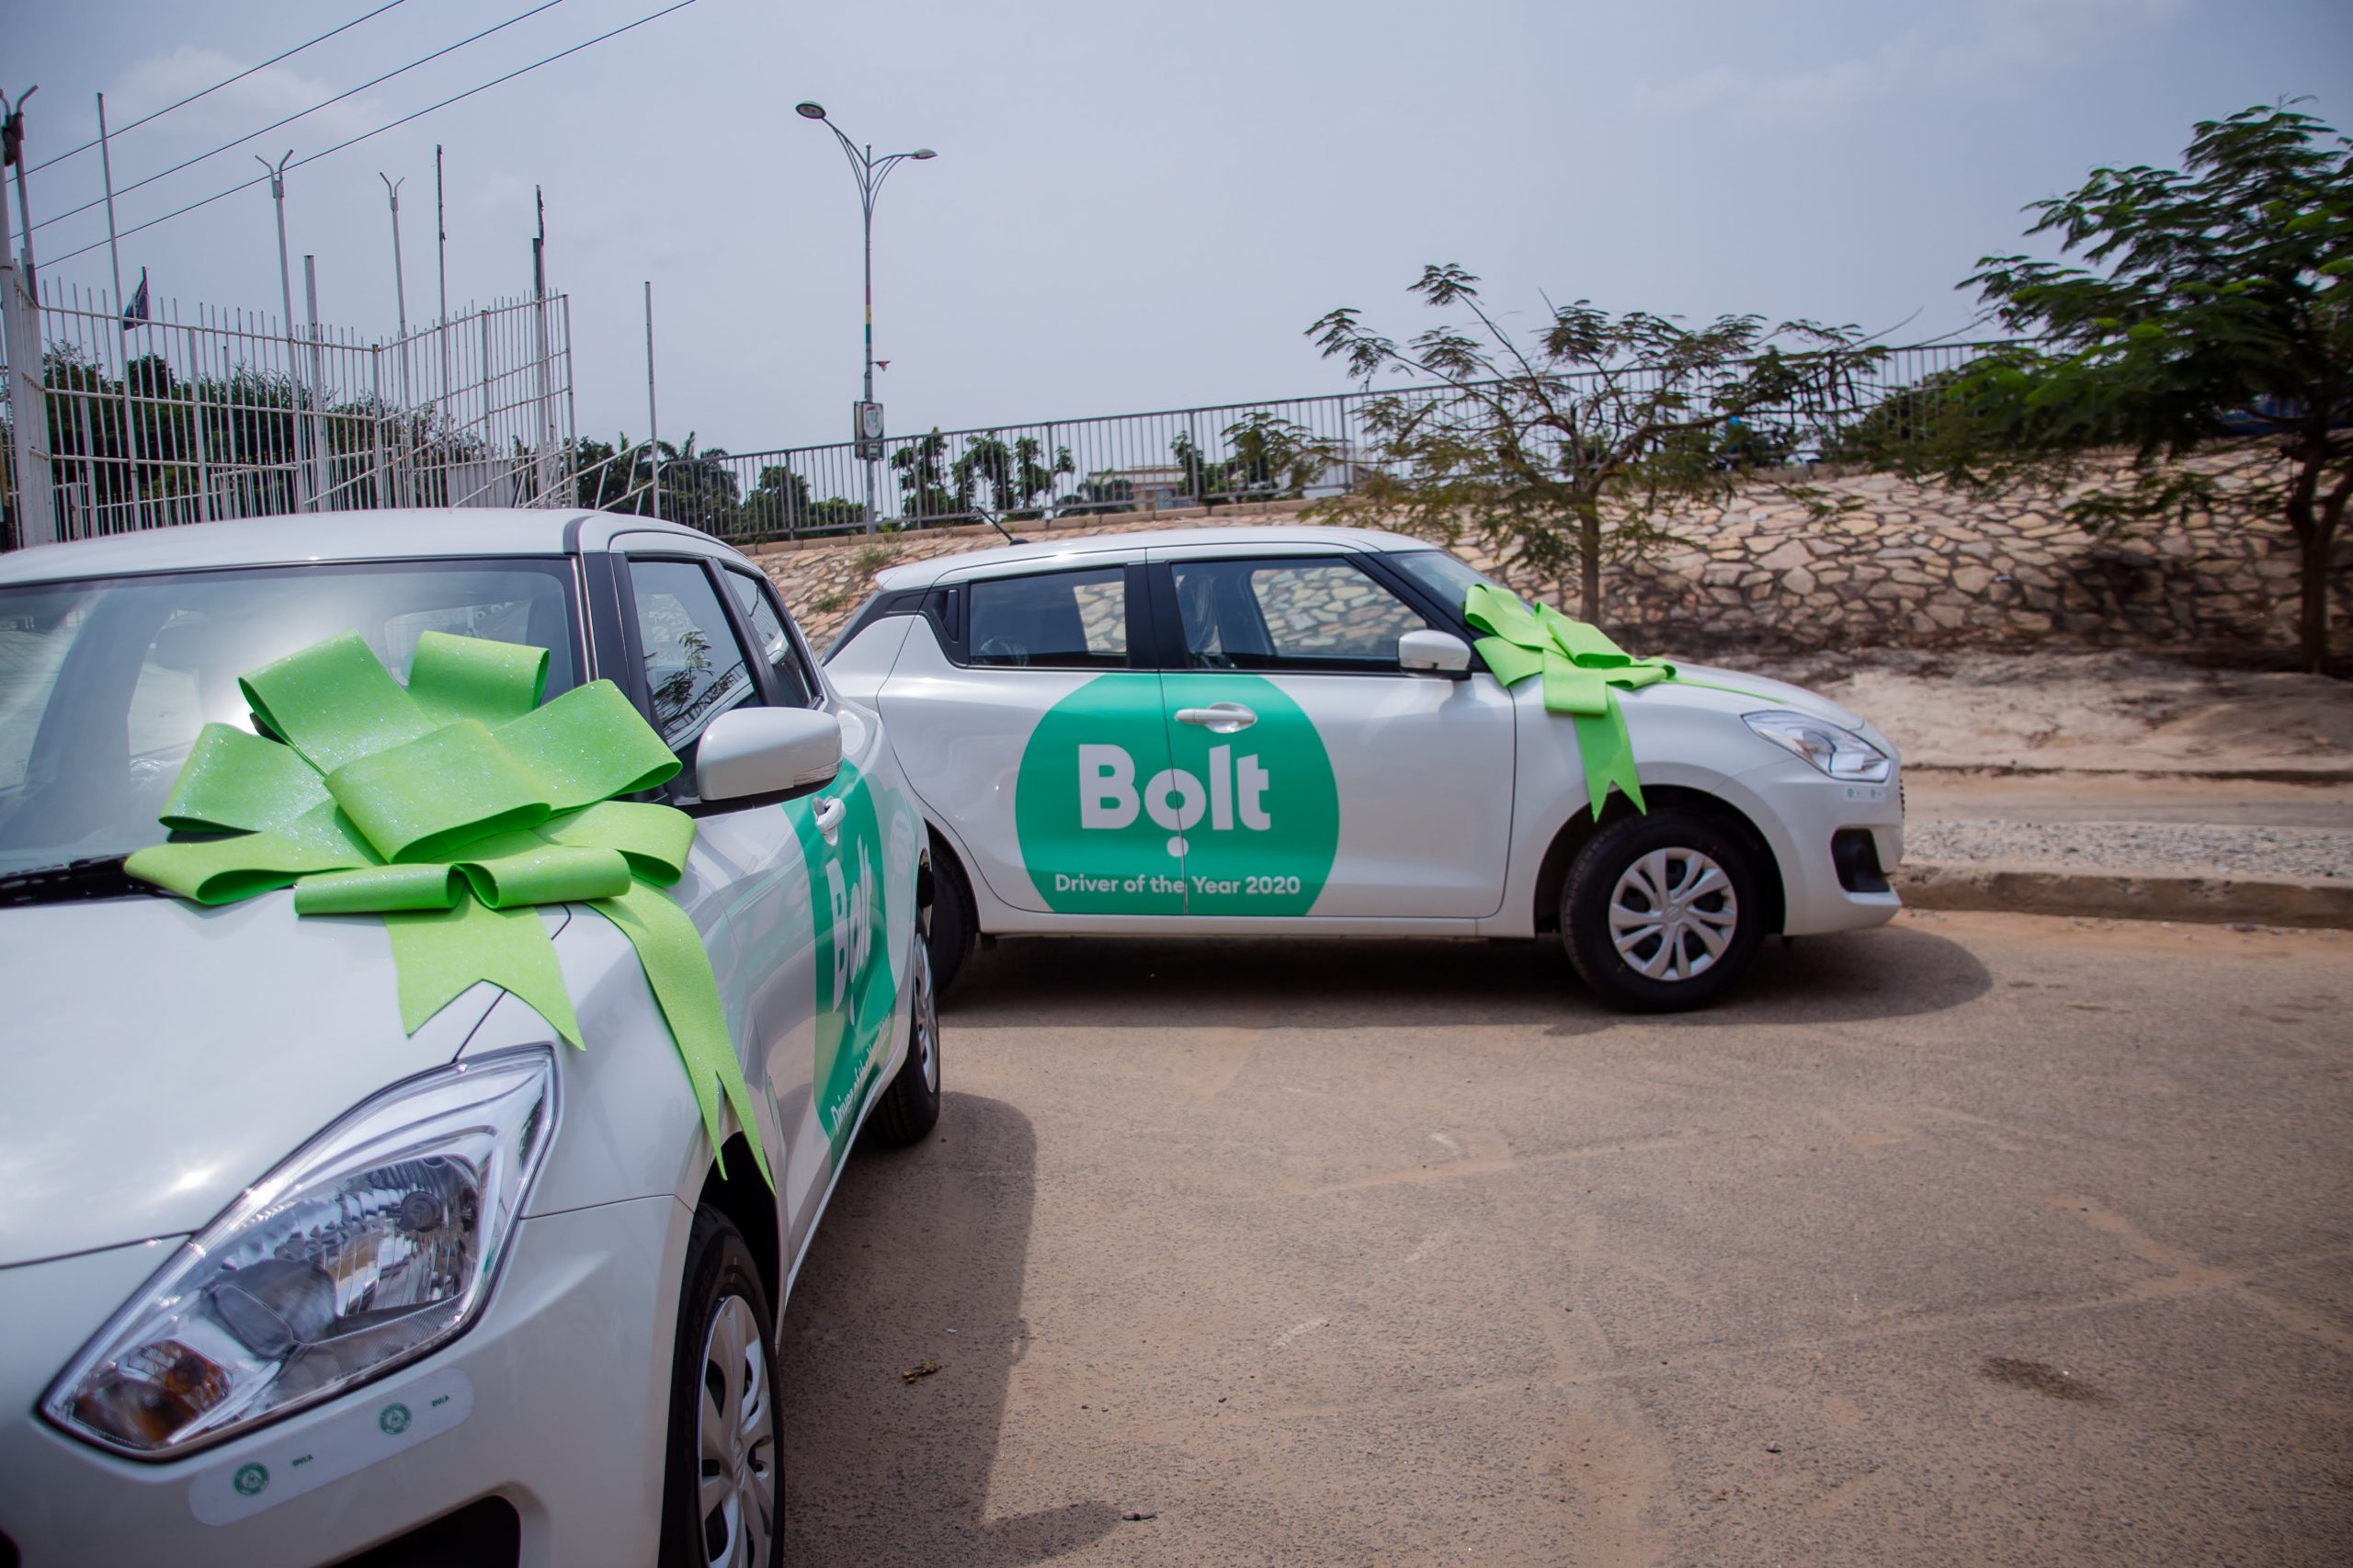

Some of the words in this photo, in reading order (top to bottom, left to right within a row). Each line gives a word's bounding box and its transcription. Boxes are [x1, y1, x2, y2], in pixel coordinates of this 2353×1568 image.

[1078, 744, 1272, 831] Bolt
[825, 834, 871, 1014] Bolt
[1055, 874, 1119, 892] Driver
[1123, 874, 1146, 892] of
[1149, 876, 1185, 893] the
[1191, 876, 1241, 894] Year
[1245, 876, 1301, 895] 2020
